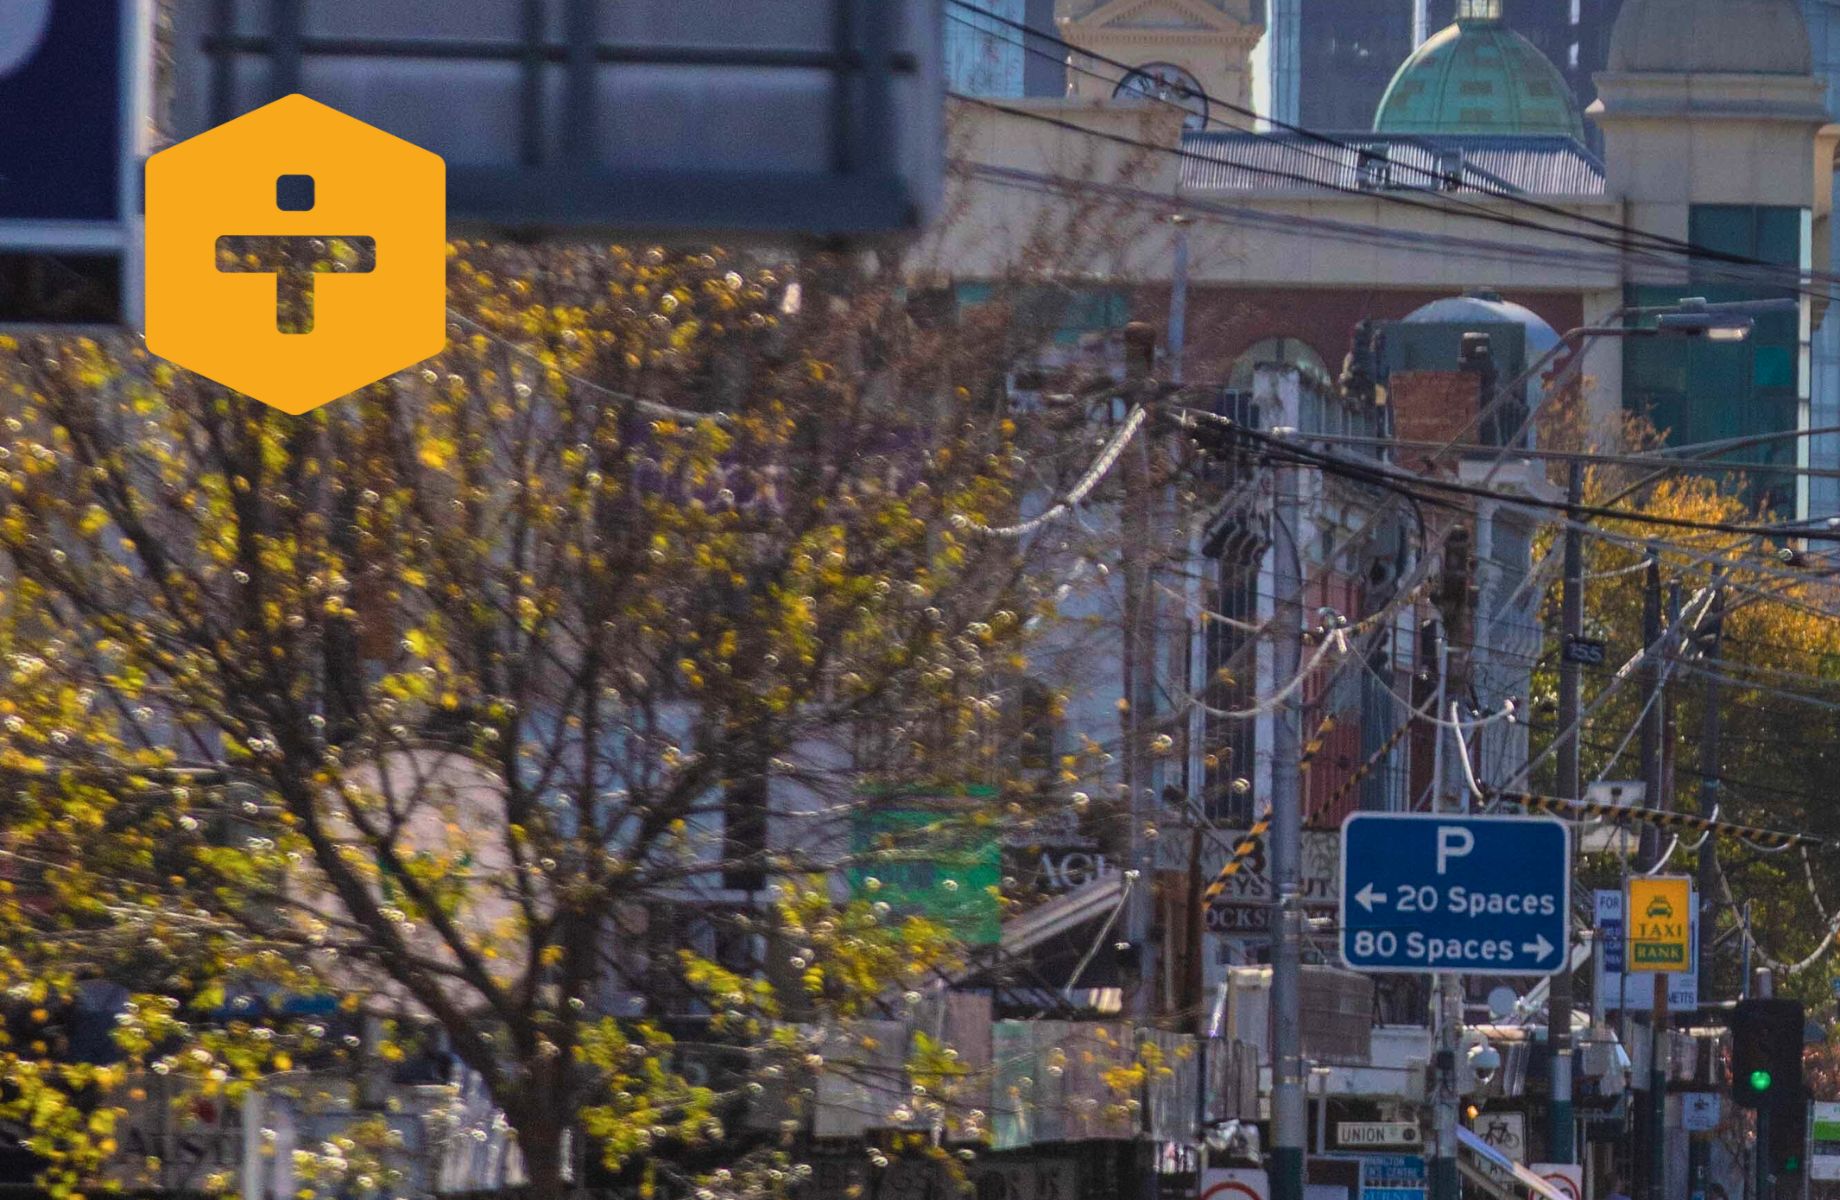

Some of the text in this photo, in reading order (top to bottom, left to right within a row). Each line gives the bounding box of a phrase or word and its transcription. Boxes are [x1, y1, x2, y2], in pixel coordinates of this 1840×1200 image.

[1437, 826, 1475, 875] P
[1397, 885, 1556, 918] 20 Spaces
[1638, 923, 1683, 938] TAXI
[1354, 931, 1514, 962] 80 Spaces
[1636, 943, 1683, 960] RANK
[1342, 1127, 1386, 1142] UNION
